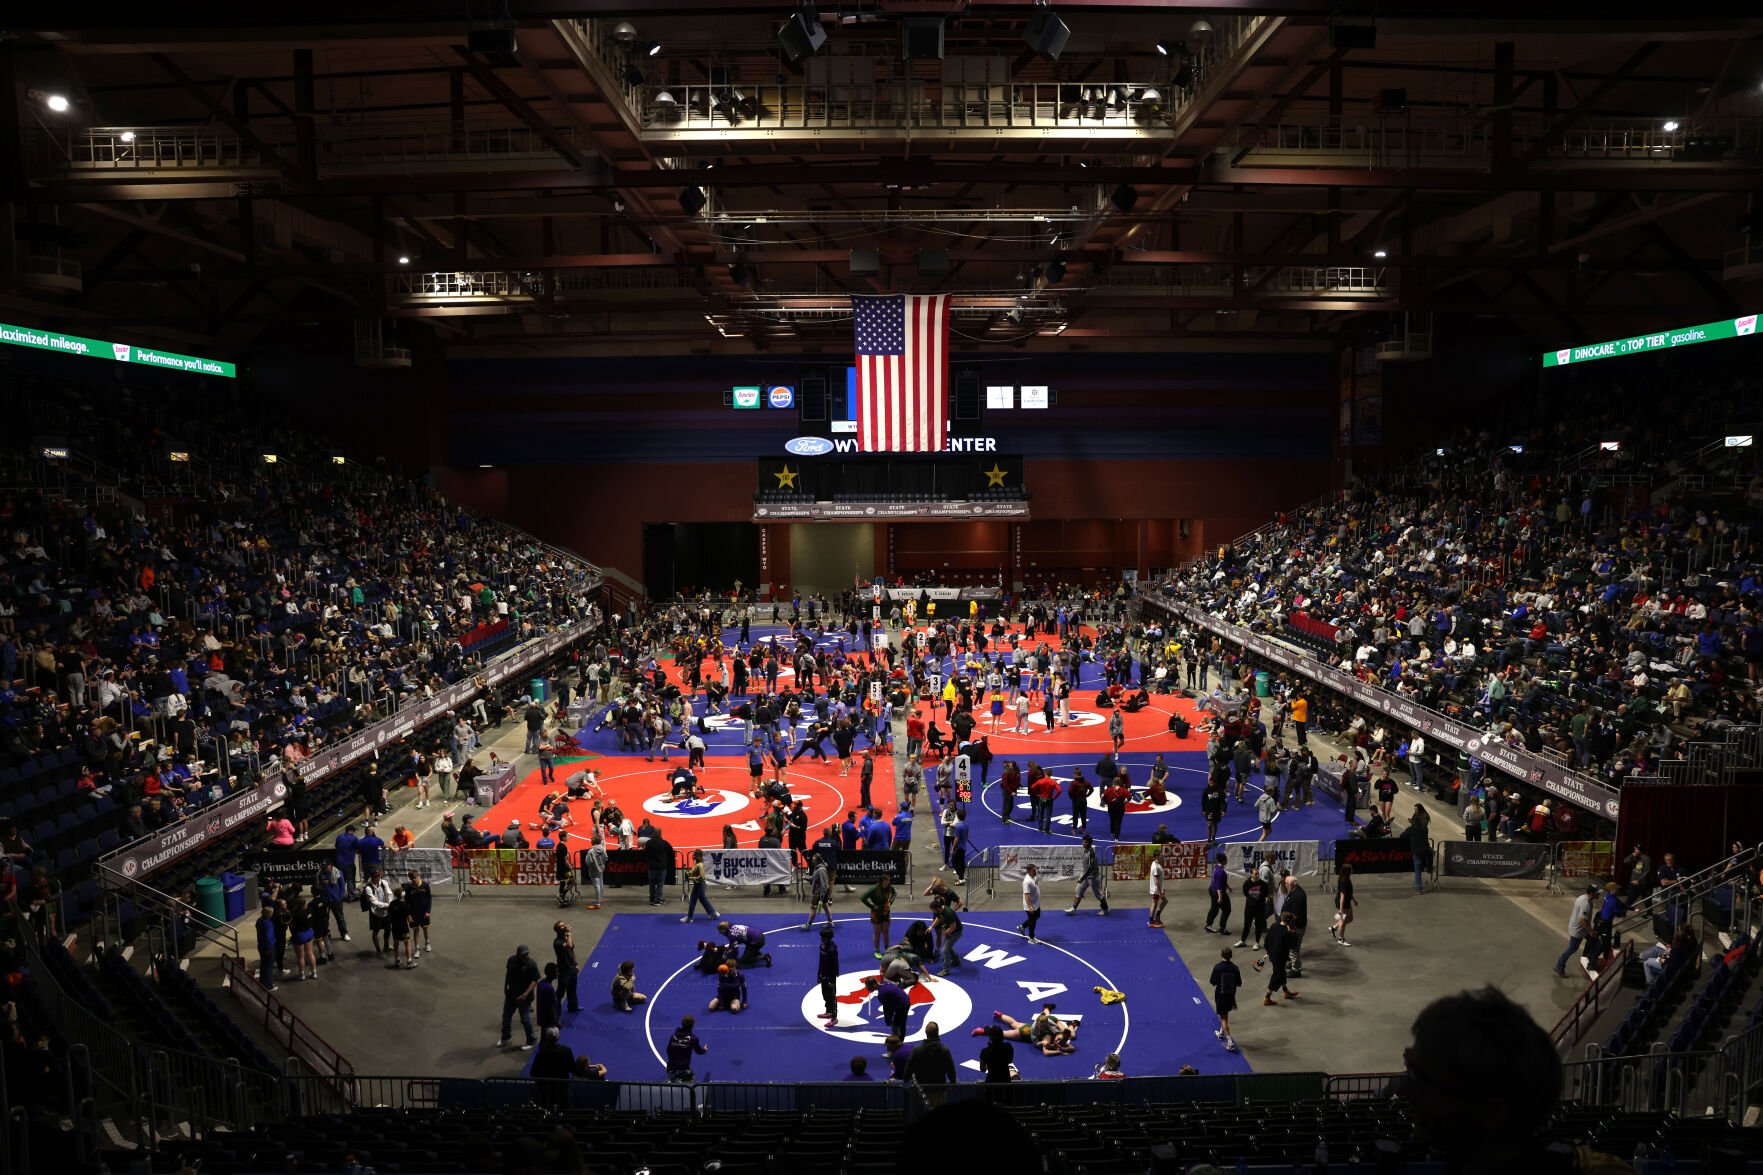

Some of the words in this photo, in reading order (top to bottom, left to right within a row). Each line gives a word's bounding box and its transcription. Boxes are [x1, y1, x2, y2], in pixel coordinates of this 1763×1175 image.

[50, 337, 90, 354] mileage.
[1621, 344, 1626, 352] a
[1628, 338, 1645, 350] TOP
[1671, 330, 1706, 346] gasoline.
[138, 350, 183, 367] Performance
[203, 363, 223, 373] notice.
[794, 440, 824, 452] Ford
[1400, 703, 1414, 715] STATE
[1444, 722, 1460, 736] STATE
[351, 736, 366, 750] STATE
[1431, 727, 1466, 747] CHAMPIONSHIPS
[340, 740, 376, 764] CHAMPIONSHIPS
[1499, 748, 1518, 763] STATE
[299, 762, 316, 776] STATE
[958, 758, 967, 771] 4
[1480, 750, 1528, 778] CHAMPIONSHIPS
[1563, 776, 1585, 792] STATE
[239, 792, 259, 809] STATE
[1545, 780, 1601, 811] CHAMPIONSHIPS
[224, 796, 273, 828] CHAMPIONSHIPS
[161, 828, 188, 848] STATE
[141, 830, 206, 871] CHAMPIONSHIPS
[1161, 844, 1207, 857] DON'T
[262, 860, 306, 872] Pinnacle
[517, 862, 550, 872] TEXT
[607, 861, 649, 873] StateFa
[723, 857, 768, 869] BUCKLE
[836, 859, 871, 871] nnacle
[871, 860, 897, 871] Bank
[1163, 856, 1194, 867] TEXT
[1466, 859, 1521, 867] CHAMPIONSHIPS
[723, 868, 739, 878] UP
[1162, 867, 1206, 878] DRIVE
